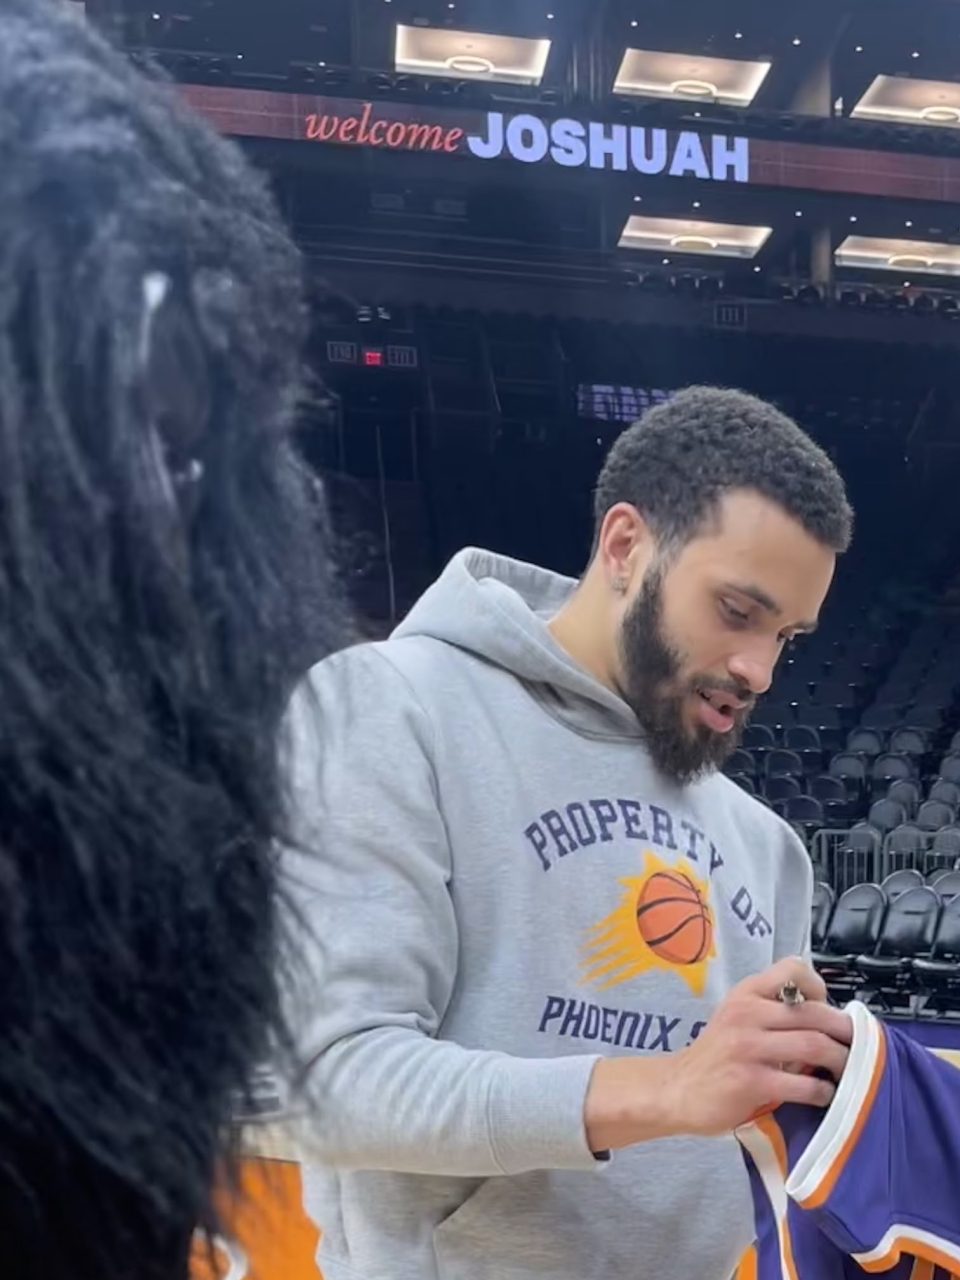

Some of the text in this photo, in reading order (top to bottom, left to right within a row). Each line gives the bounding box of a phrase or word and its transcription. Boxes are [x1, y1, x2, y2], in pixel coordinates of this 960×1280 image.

[305, 102, 749, 183] welcome JOSHUAH
[523, 798, 773, 939] PROPERTY OF
[537, 995, 681, 1052] PHOENIX
